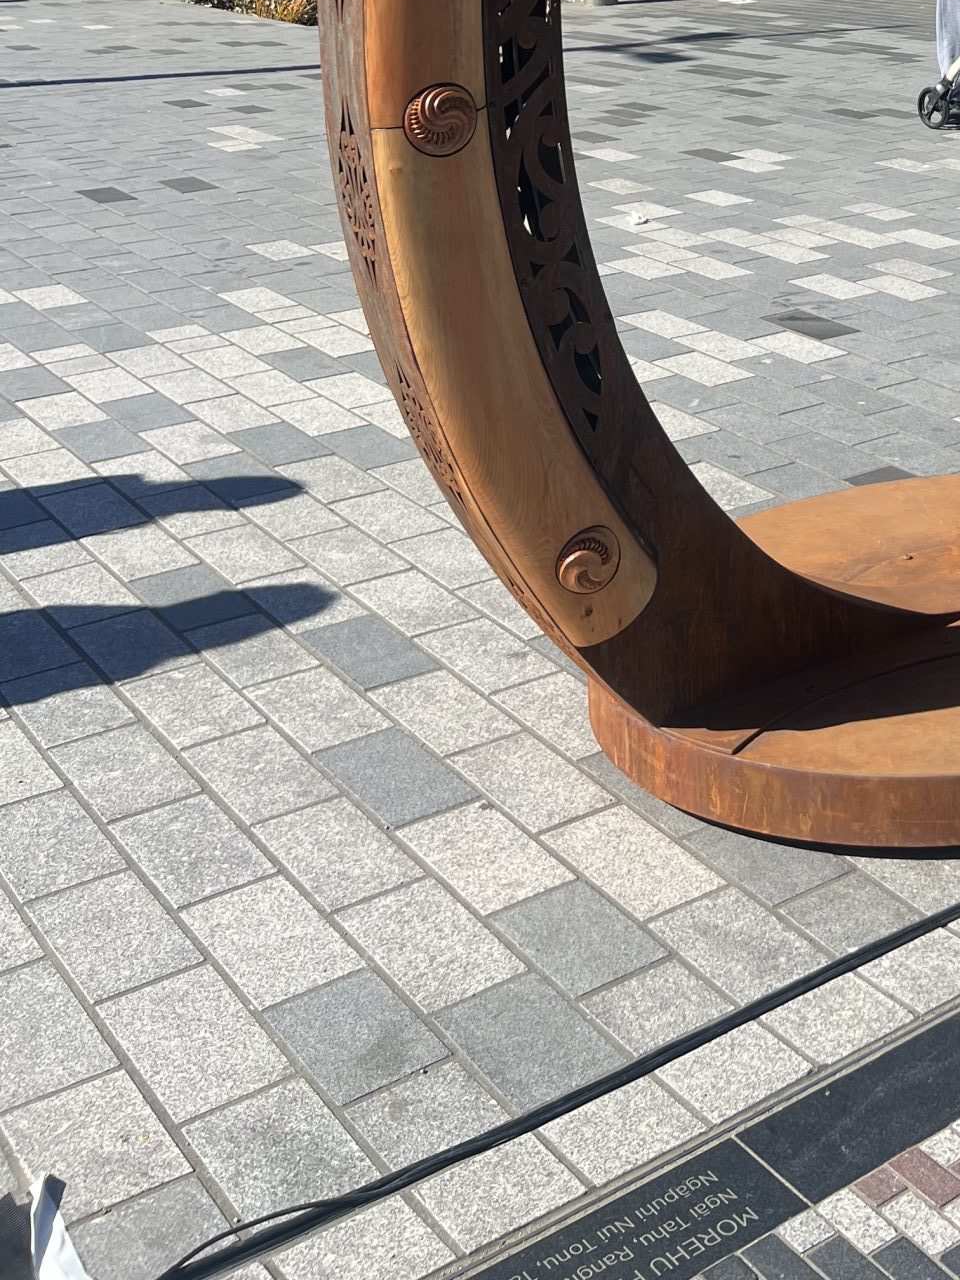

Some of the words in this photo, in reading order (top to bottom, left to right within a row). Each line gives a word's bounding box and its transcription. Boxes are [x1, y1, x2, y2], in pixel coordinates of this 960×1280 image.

[634, 1170, 719, 1222] Ngāpuhi
[689, 1188, 738, 1221] Ngāi
[596, 1216, 635, 1244] Nui
[632, 1216, 691, 1247] Tahu,
[649, 1206, 760, 1276] MOREHU
[536, 1237, 598, 1271] Tonu,
